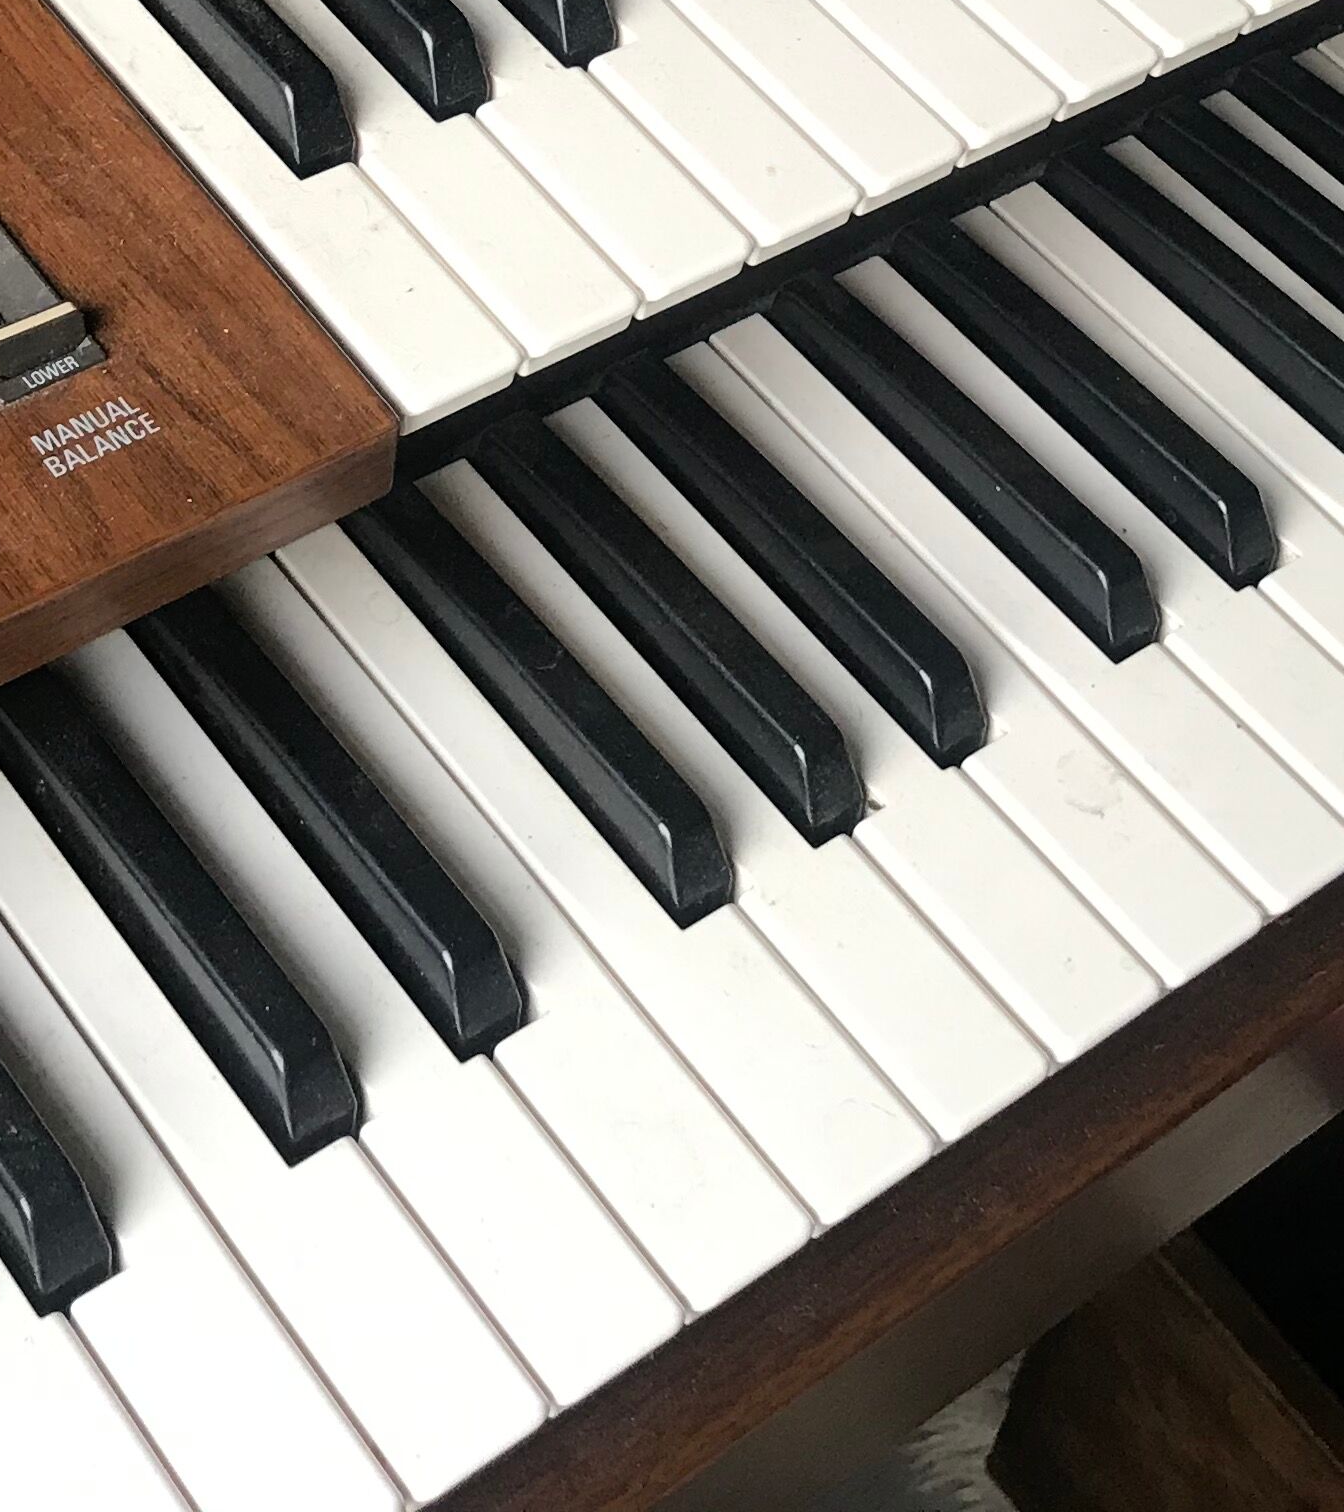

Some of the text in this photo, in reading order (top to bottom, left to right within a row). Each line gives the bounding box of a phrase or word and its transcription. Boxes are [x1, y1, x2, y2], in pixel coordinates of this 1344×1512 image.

[21, 355, 80, 390] LOWER
[30, 395, 143, 457] MANUAL
[42, 411, 161, 480] BALANCE
